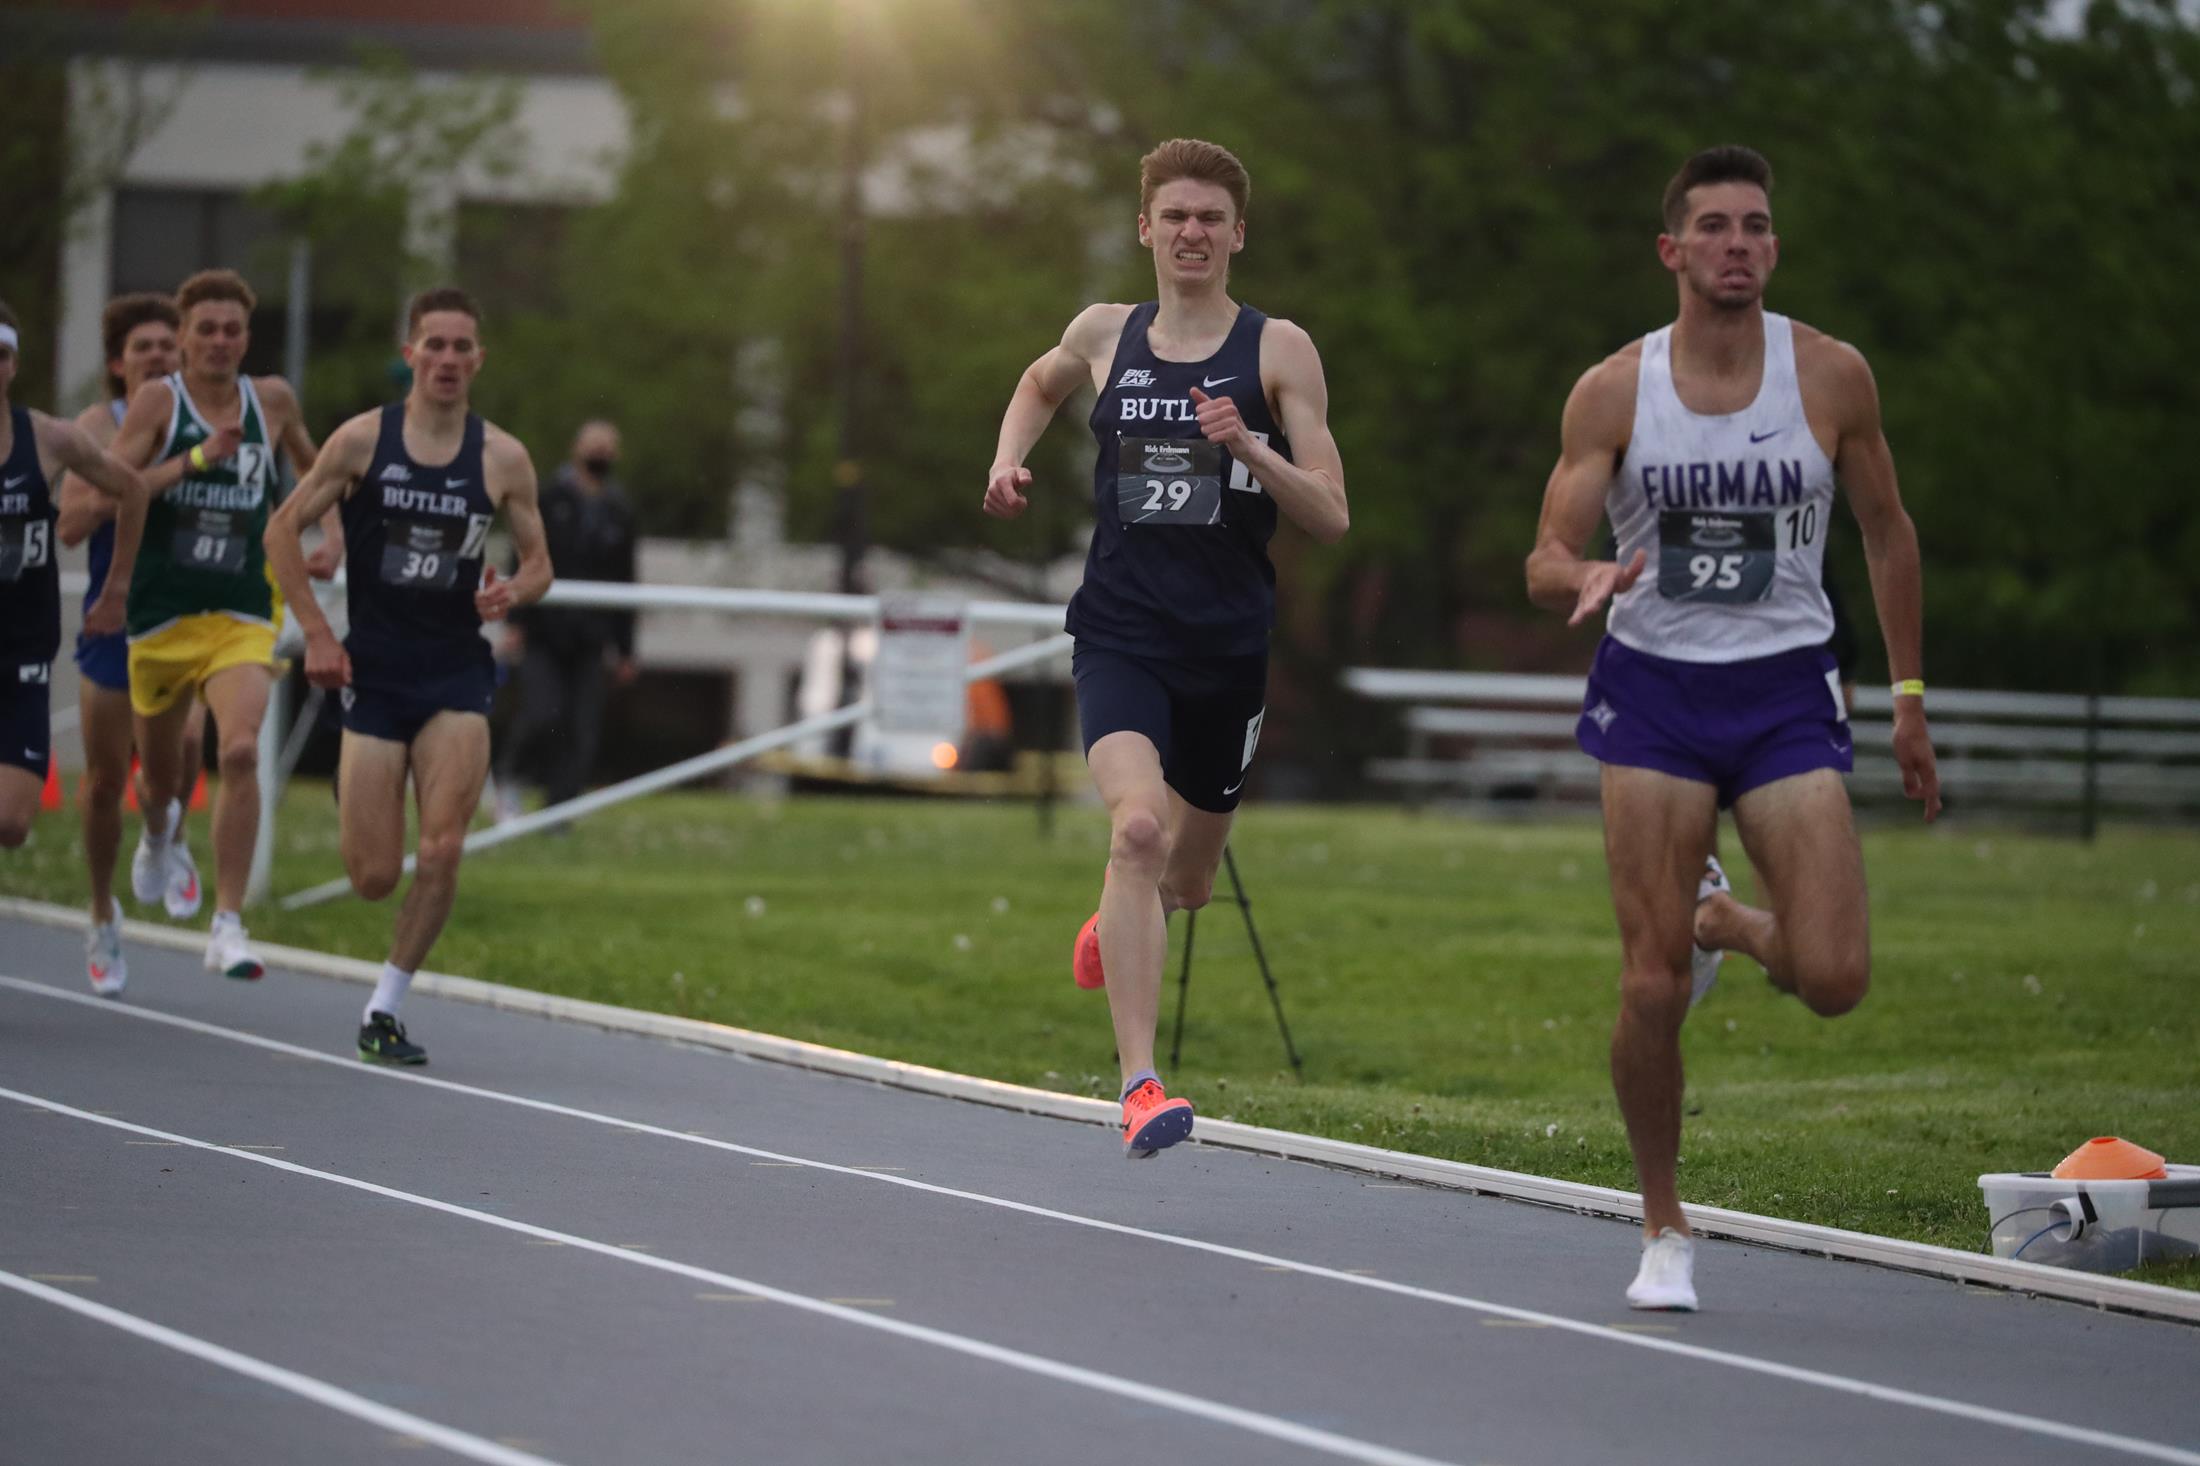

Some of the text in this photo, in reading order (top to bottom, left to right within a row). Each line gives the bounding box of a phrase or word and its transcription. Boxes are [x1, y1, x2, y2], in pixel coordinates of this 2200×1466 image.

[1118, 377, 1157, 385] EAST
[1124, 369, 1151, 377] BIG
[1120, 398, 1200, 421] BUTL
[246, 447, 261, 485] 2
[1141, 479, 1192, 511] 29
[1642, 459, 1803, 509] FURMAN
[383, 485, 468, 517] BUTLER
[1786, 503, 1816, 550] 10
[31, 524, 43, 562] 5
[401, 551, 440, 579] 30
[1689, 554, 1744, 591] 95
